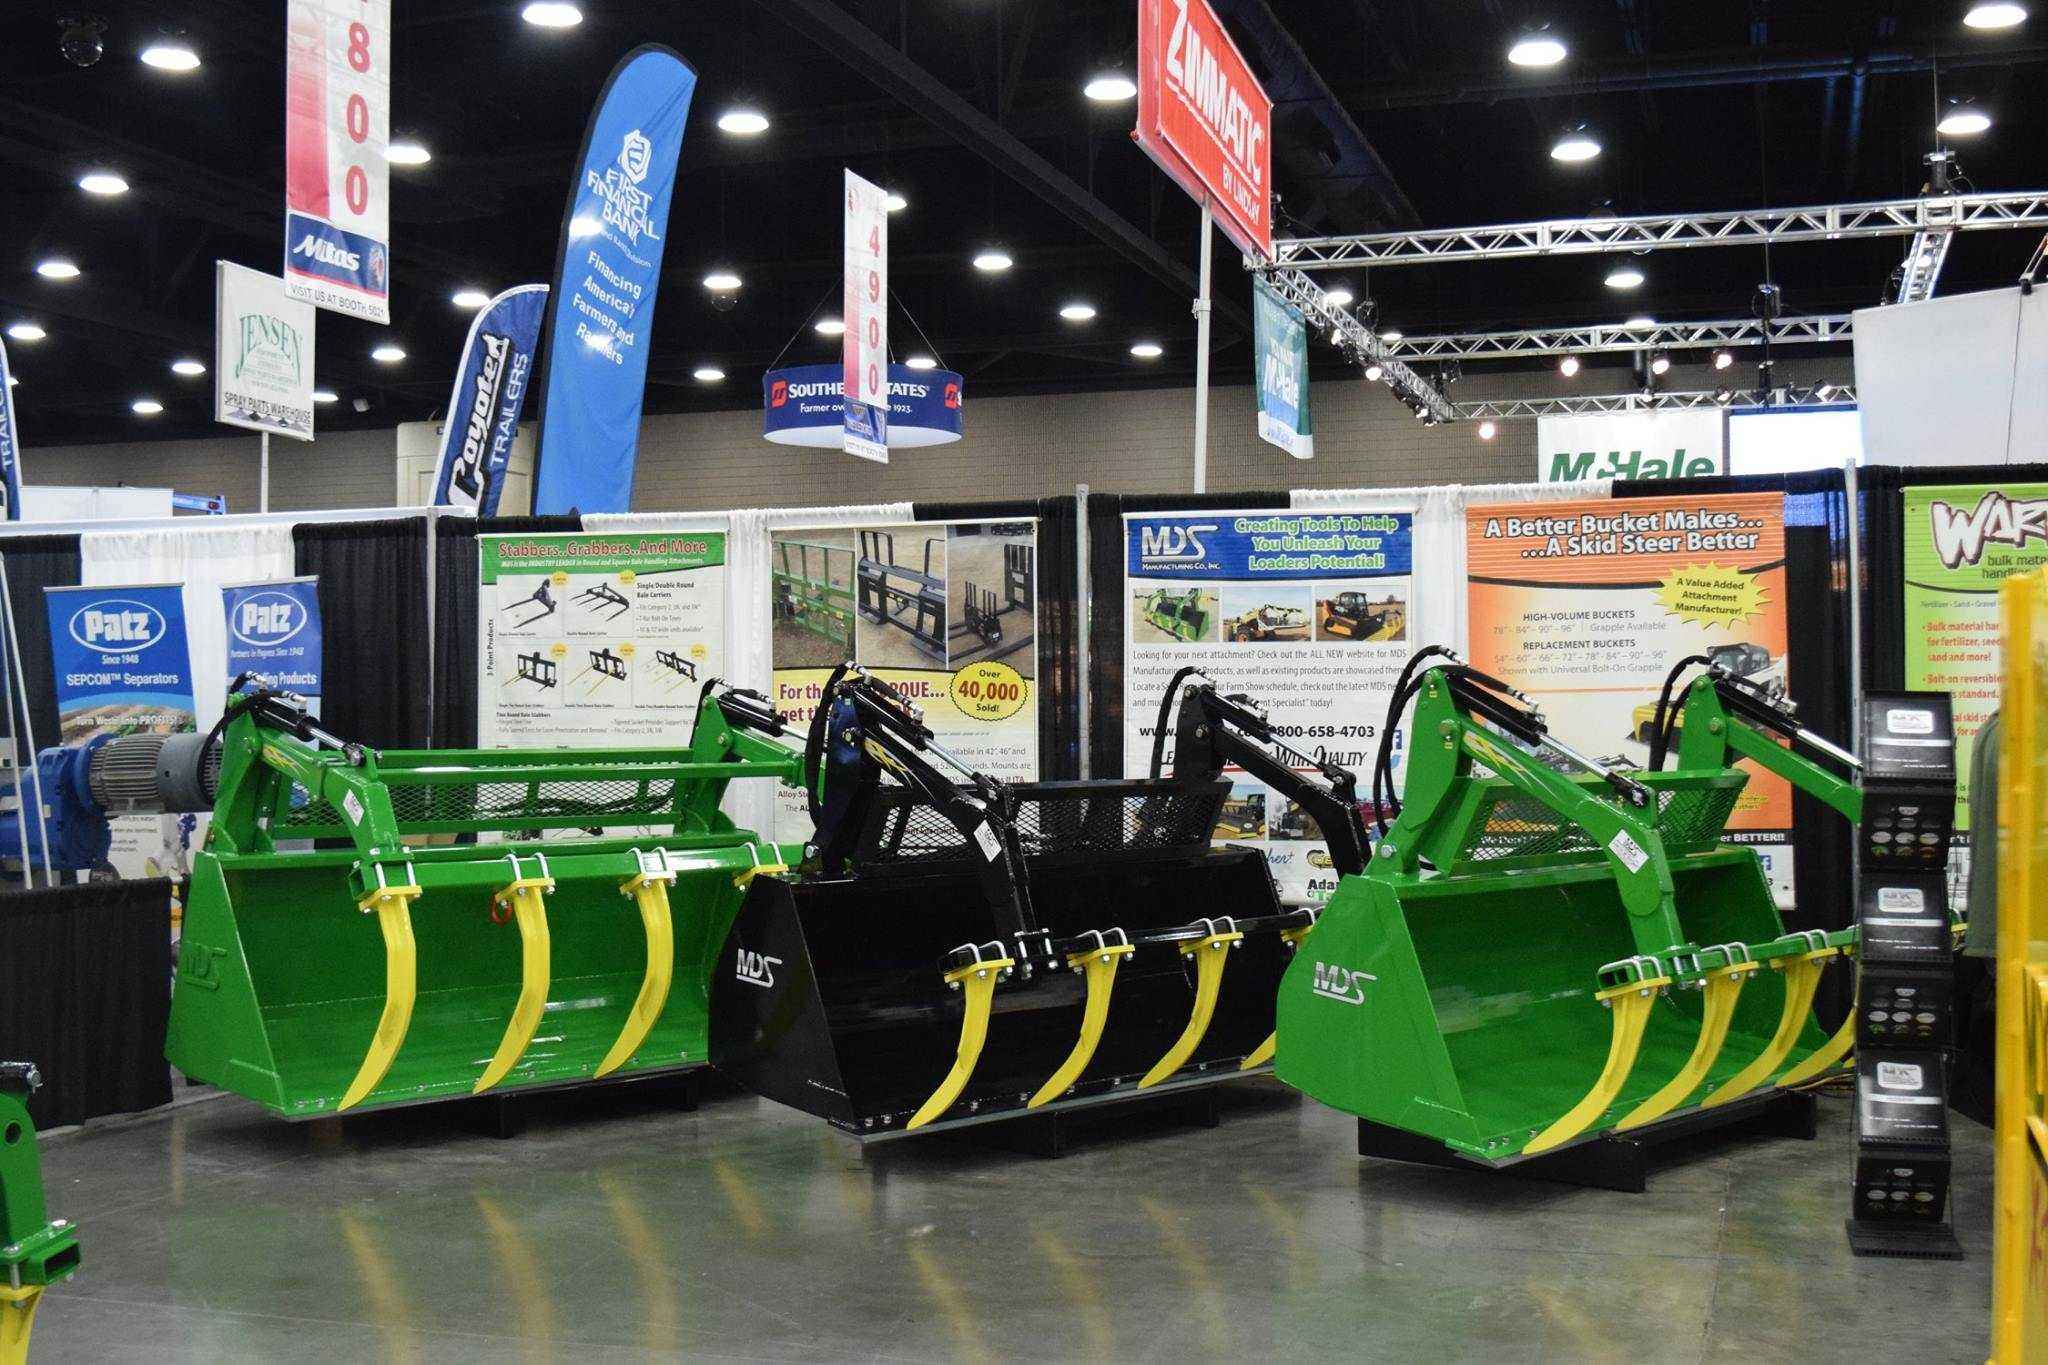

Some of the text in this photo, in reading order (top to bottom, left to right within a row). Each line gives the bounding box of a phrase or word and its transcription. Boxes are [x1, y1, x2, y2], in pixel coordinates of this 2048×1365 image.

[346, 0, 370, 215] 800
[606, 168, 653, 209] FIRST
[602, 205, 640, 246] BANK
[293, 234, 360, 272] Mitas
[587, 250, 642, 299] Financing
[291, 284, 367, 313] VISIT US AT BOOTH
[573, 293, 617, 334] Farmers
[788, 382, 926, 399] SOUTHE TATES
[224, 391, 246, 409] SPRAY
[490, 352, 529, 468] TRAILERS
[800, 403, 831, 416] Farmer
[1235, 515, 1398, 535] Creating Tools To Help
[1484, 508, 1763, 538] A Better Bucket Makes...
[639, 539, 707, 555] And More
[1142, 525, 1219, 561] MDS
[1252, 535, 1382, 551] You Unleash Your
[1567, 534, 1617, 556] Skid
[1622, 533, 1682, 553] Steer
[1686, 530, 1759, 551] Better
[1249, 553, 1385, 570] Loaders Potential!
[1987, 555, 2012, 566] bulk
[637, 582, 654, 590] Single
[1676, 577, 1744, 590] A Value Added
[1681, 590, 1737, 602] Attachment
[1523, 610, 1635, 621] HIGH-VOLUME BUCKETS
[1674, 603, 1742, 615] Manufacturer!
[84, 609, 150, 641] Patz
[242, 602, 291, 635] Patz
[1948, 621, 1984, 631] material
[486, 619, 494, 650] Products
[1590, 621, 1666, 633] Grapple Available
[1523, 639, 1636, 650] REPLACEMENT BUCKETS
[101, 654, 140, 665] Since 1948
[1133, 651, 1159, 661] Looking
[1162, 650, 1172, 658] for
[1174, 652, 1189, 661] your
[1193, 651, 1207, 659] next
[1210, 650, 1255, 659] attachment?
[1257, 650, 1277, 659] Check
[1280, 650, 1292, 658] out
[1295, 650, 1307, 658] the
[1310, 650, 1325, 658] ALL
[1326, 649, 1343, 658] NEW
[1346, 650, 1374, 658] website
[1377, 650, 1388, 658] for
[979, 669, 1001, 678] Over
[1133, 666, 1179, 675] Manufacturin
[1236, 667, 1245, 675] as
[1246, 666, 1261, 675] well
[1270, 666, 1298, 677] existing
[1300, 666, 1331, 677] products
[1333, 667, 1342, 675] are
[1346, 666, 1383, 675] showcased
[1551, 665, 1591, 674] Universal
[1627, 664, 1664, 674] Grapple
[123, 672, 180, 687] Separators
[279, 671, 318, 686] Products
[780, 683, 802, 700] For
[806, 682, 822, 699] th
[958, 680, 1018, 702] 40,000
[1226, 682, 1244, 691] Farm
[1245, 682, 1264, 691] Show
[1300, 682, 1320, 691] check
[1321, 683, 1333, 691] out
[1335, 682, 1348, 691] the
[1349, 682, 1369, 691] latest
[976, 703, 1000, 713] Sold!
[1133, 698, 1333, 709] and today!
[976, 747, 1026, 755] in and
[991, 761, 1018, 770] Mounts
[778, 791, 797, 799] Alloy
[785, 804, 798, 812] The
[1733, 833, 1785, 842] BETTER!!
[736, 948, 783, 988] MDS
[1312, 961, 1378, 1005] MDS
